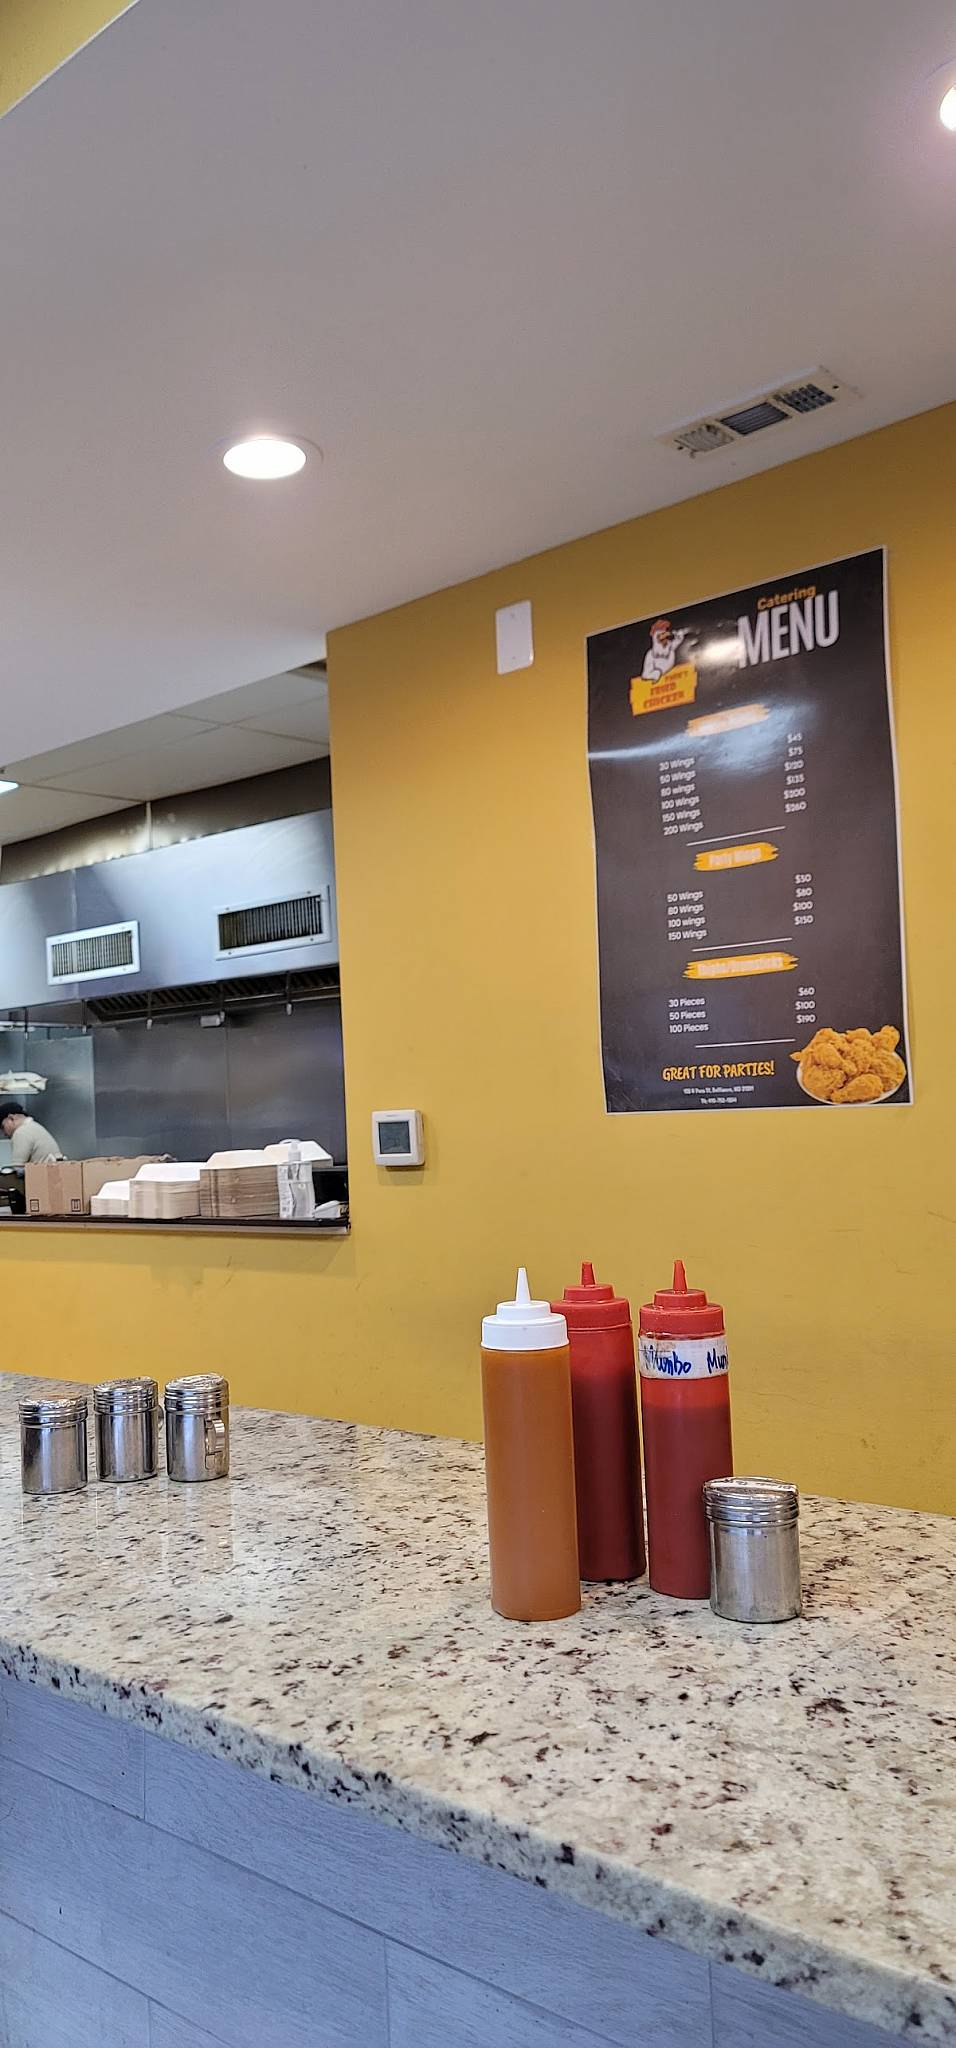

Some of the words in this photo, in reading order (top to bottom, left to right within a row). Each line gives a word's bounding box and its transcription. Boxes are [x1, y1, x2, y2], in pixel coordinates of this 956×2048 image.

[757, 585, 816, 611] Catering
[737, 590, 840, 669] MENU
[670, 757, 695, 769] Wings
[671, 769, 696, 782] Wings
[672, 782, 696, 795] wings
[661, 799, 675, 810] 100
[675, 795, 700, 807] Wings
[676, 808, 701, 820] Wings
[663, 825, 679, 836] 200
[679, 821, 704, 834] Wings
[667, 894, 678, 903] 50
[678, 890, 704, 902] Wings
[667, 906, 679, 915] 80
[679, 903, 704, 915] Wings
[792, 901, 813, 912] $100
[668, 918, 682, 928] 100
[682, 915, 706, 927] wings
[668, 931, 682, 941] 150
[682, 928, 708, 940] Wings
[798, 986, 815, 997] $60
[668, 998, 679, 1008] 30
[679, 997, 706, 1007] Pieces
[795, 1000, 816, 1011] $100
[669, 1011, 680, 1021] 50
[680, 1010, 706, 1020] Pieces
[669, 1024, 683, 1034] 100
[683, 1022, 709, 1032] Pieces
[662, 1065, 697, 1082] GREAT
[698, 1064, 722, 1079] FOR
[722, 1060, 775, 1078] PARTIES!
